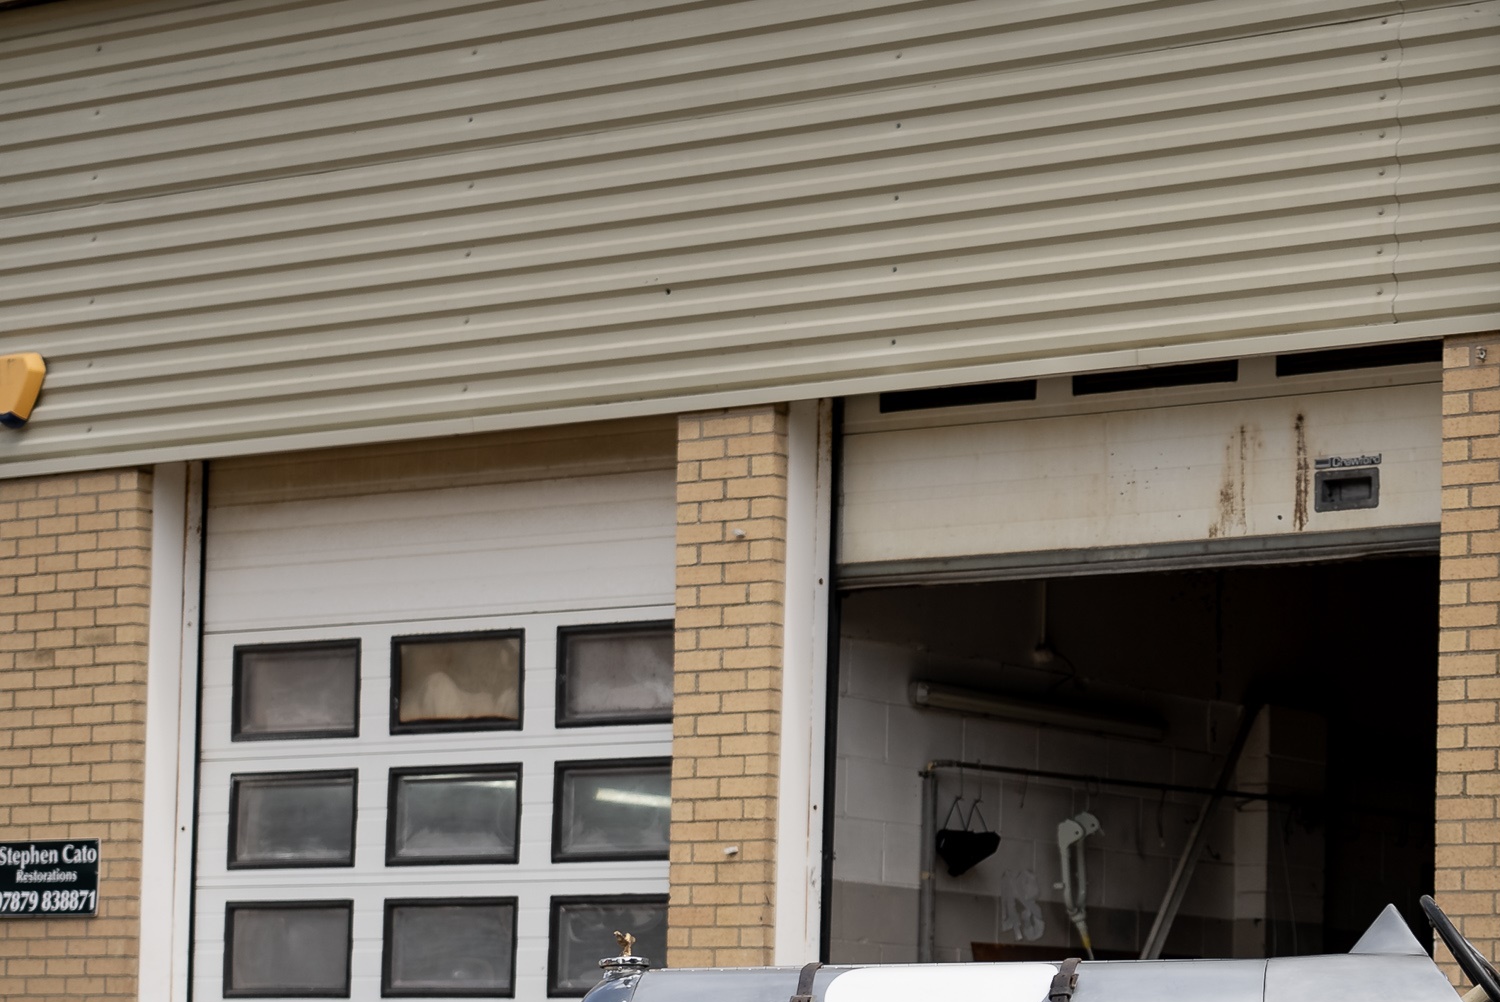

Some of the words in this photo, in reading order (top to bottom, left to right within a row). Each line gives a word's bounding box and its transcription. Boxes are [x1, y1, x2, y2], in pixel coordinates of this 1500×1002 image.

[0, 844, 59, 869] Stephen
[62, 843, 97, 864] Cato
[16, 868, 78, 883] Restorations
[0, 890, 39, 912] 7879
[41, 889, 96, 911] 838871
